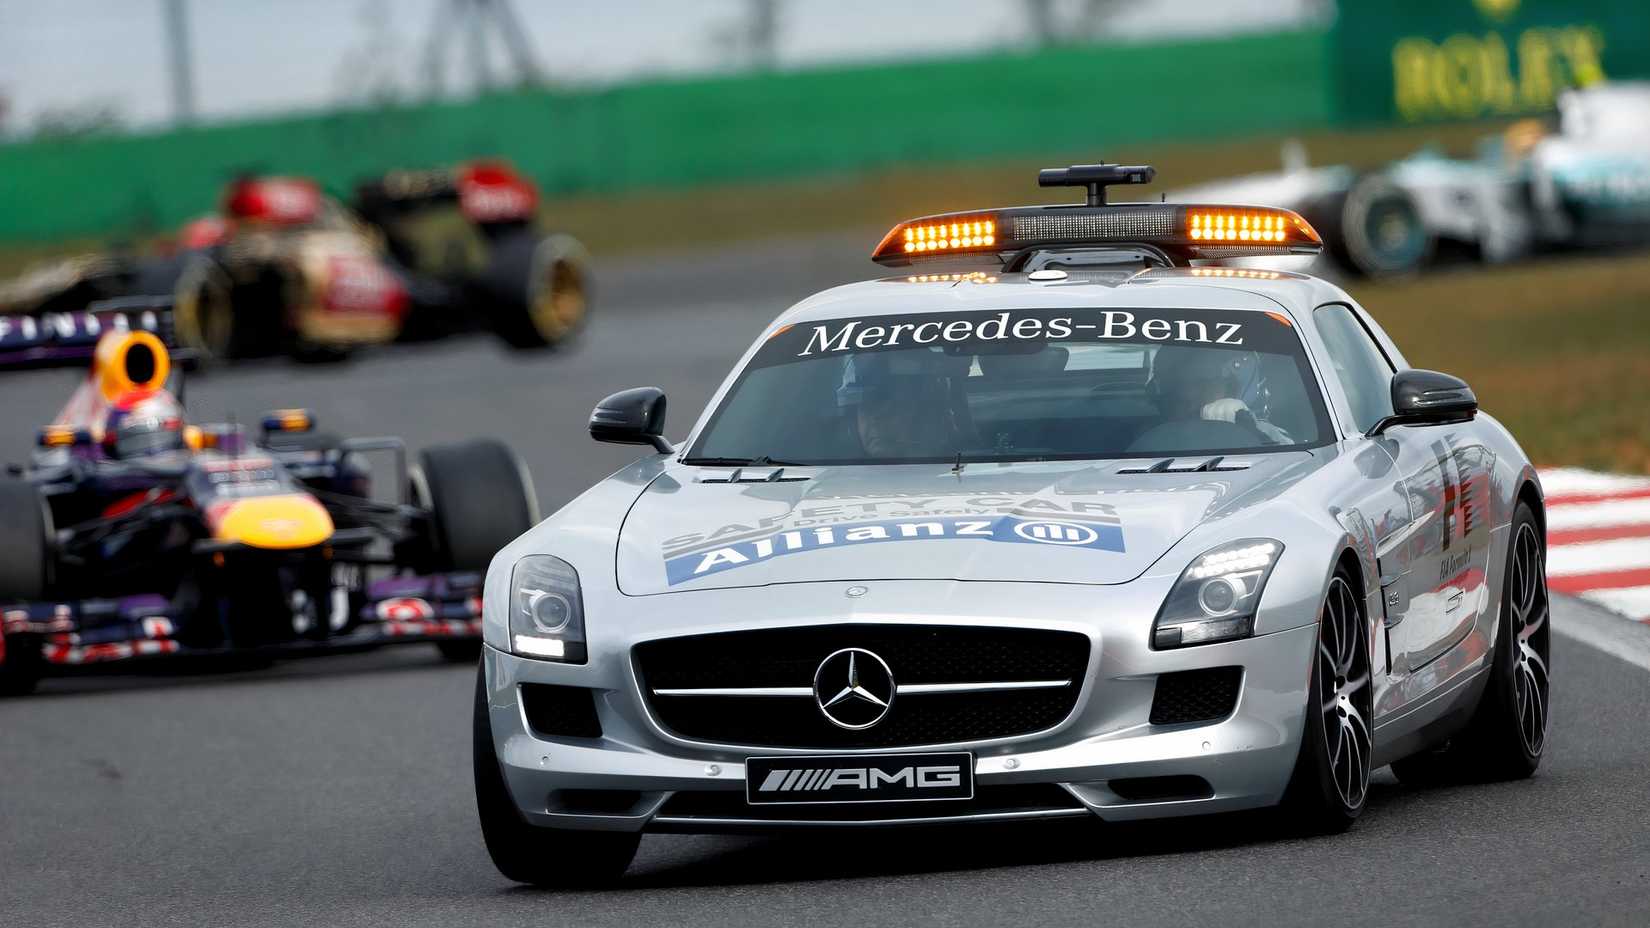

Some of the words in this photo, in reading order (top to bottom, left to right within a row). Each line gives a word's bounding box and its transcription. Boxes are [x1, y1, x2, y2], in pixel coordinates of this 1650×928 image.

[798, 311, 1243, 357] Mercedes-Benz
[966, 496, 1118, 516] CAR
[694, 521, 993, 575] Allianz
[821, 766, 961, 791] AMG
